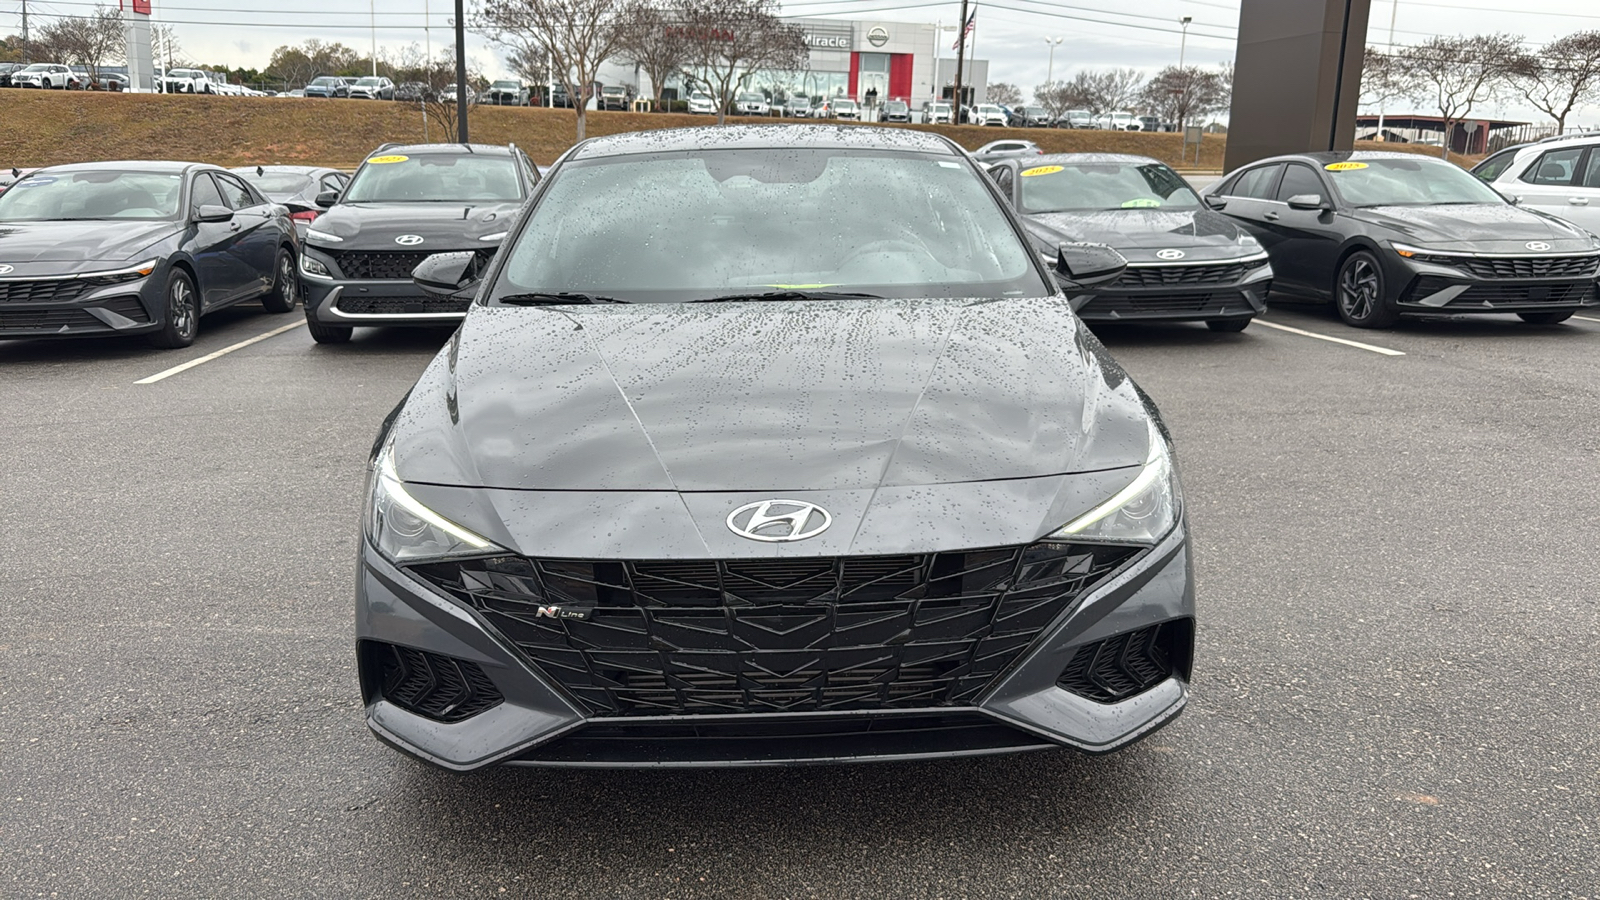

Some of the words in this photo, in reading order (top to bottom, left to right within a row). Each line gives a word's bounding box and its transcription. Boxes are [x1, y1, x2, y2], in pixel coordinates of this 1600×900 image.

[802, 34, 847, 48] Miracle
[1029, 166, 1055, 175] 2025
[535, 606, 561, 619] N
